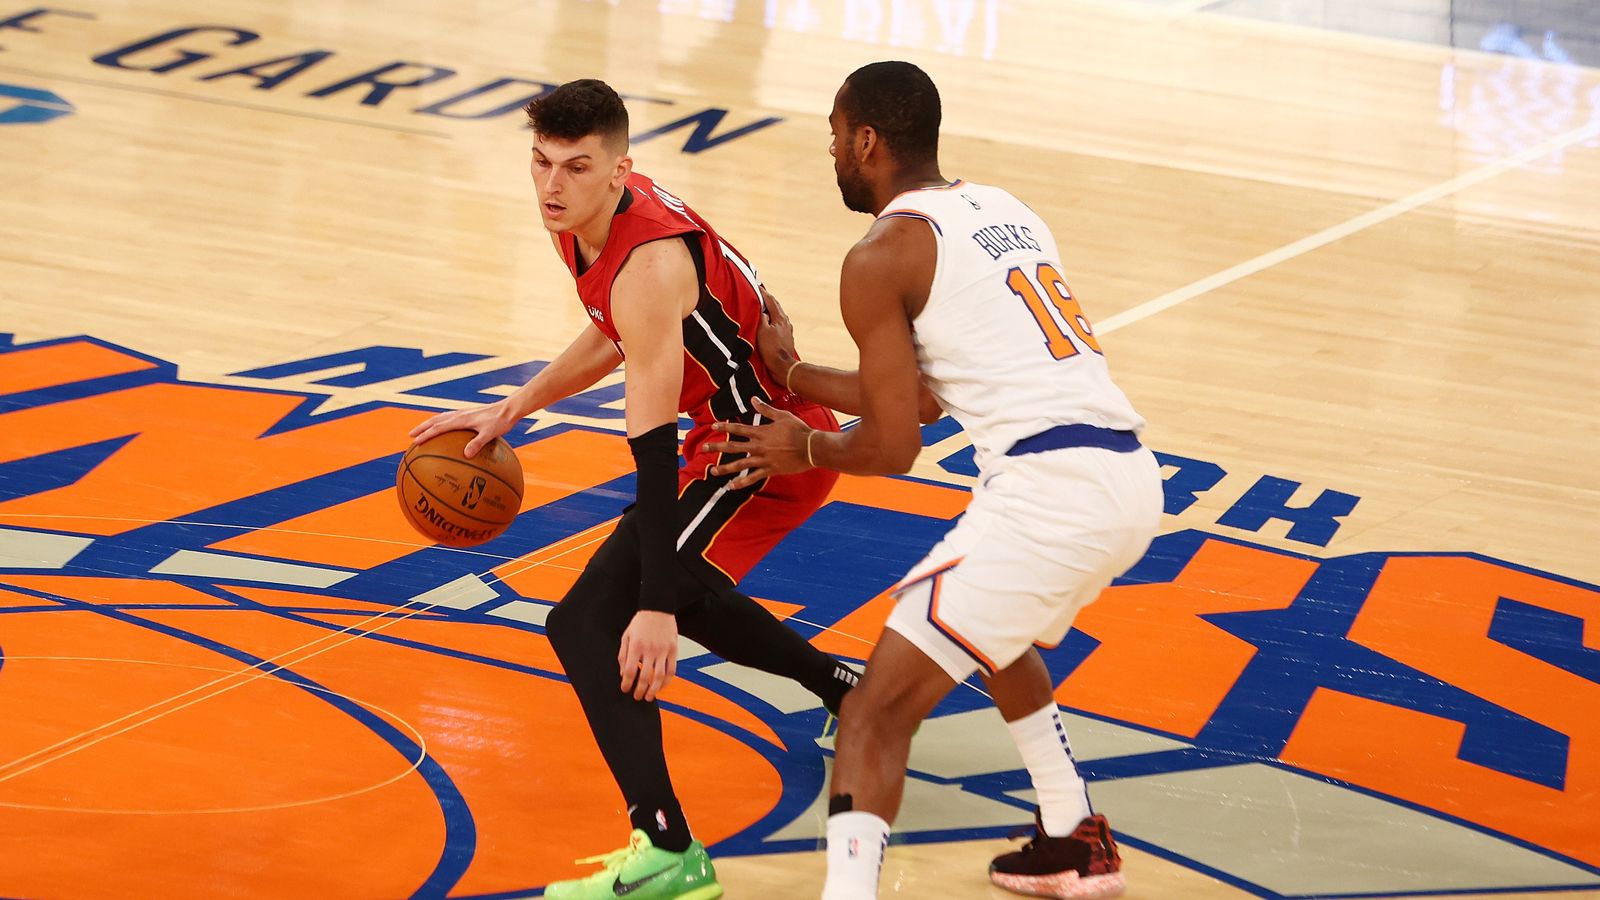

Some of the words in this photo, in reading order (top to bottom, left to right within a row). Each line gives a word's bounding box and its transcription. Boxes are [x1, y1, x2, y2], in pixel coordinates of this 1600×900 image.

[91, 25, 783, 154] GARDN
[972, 224, 1041, 260] BURKS
[1005, 262, 1104, 361] 18
[414, 492, 497, 540] SPALDING
